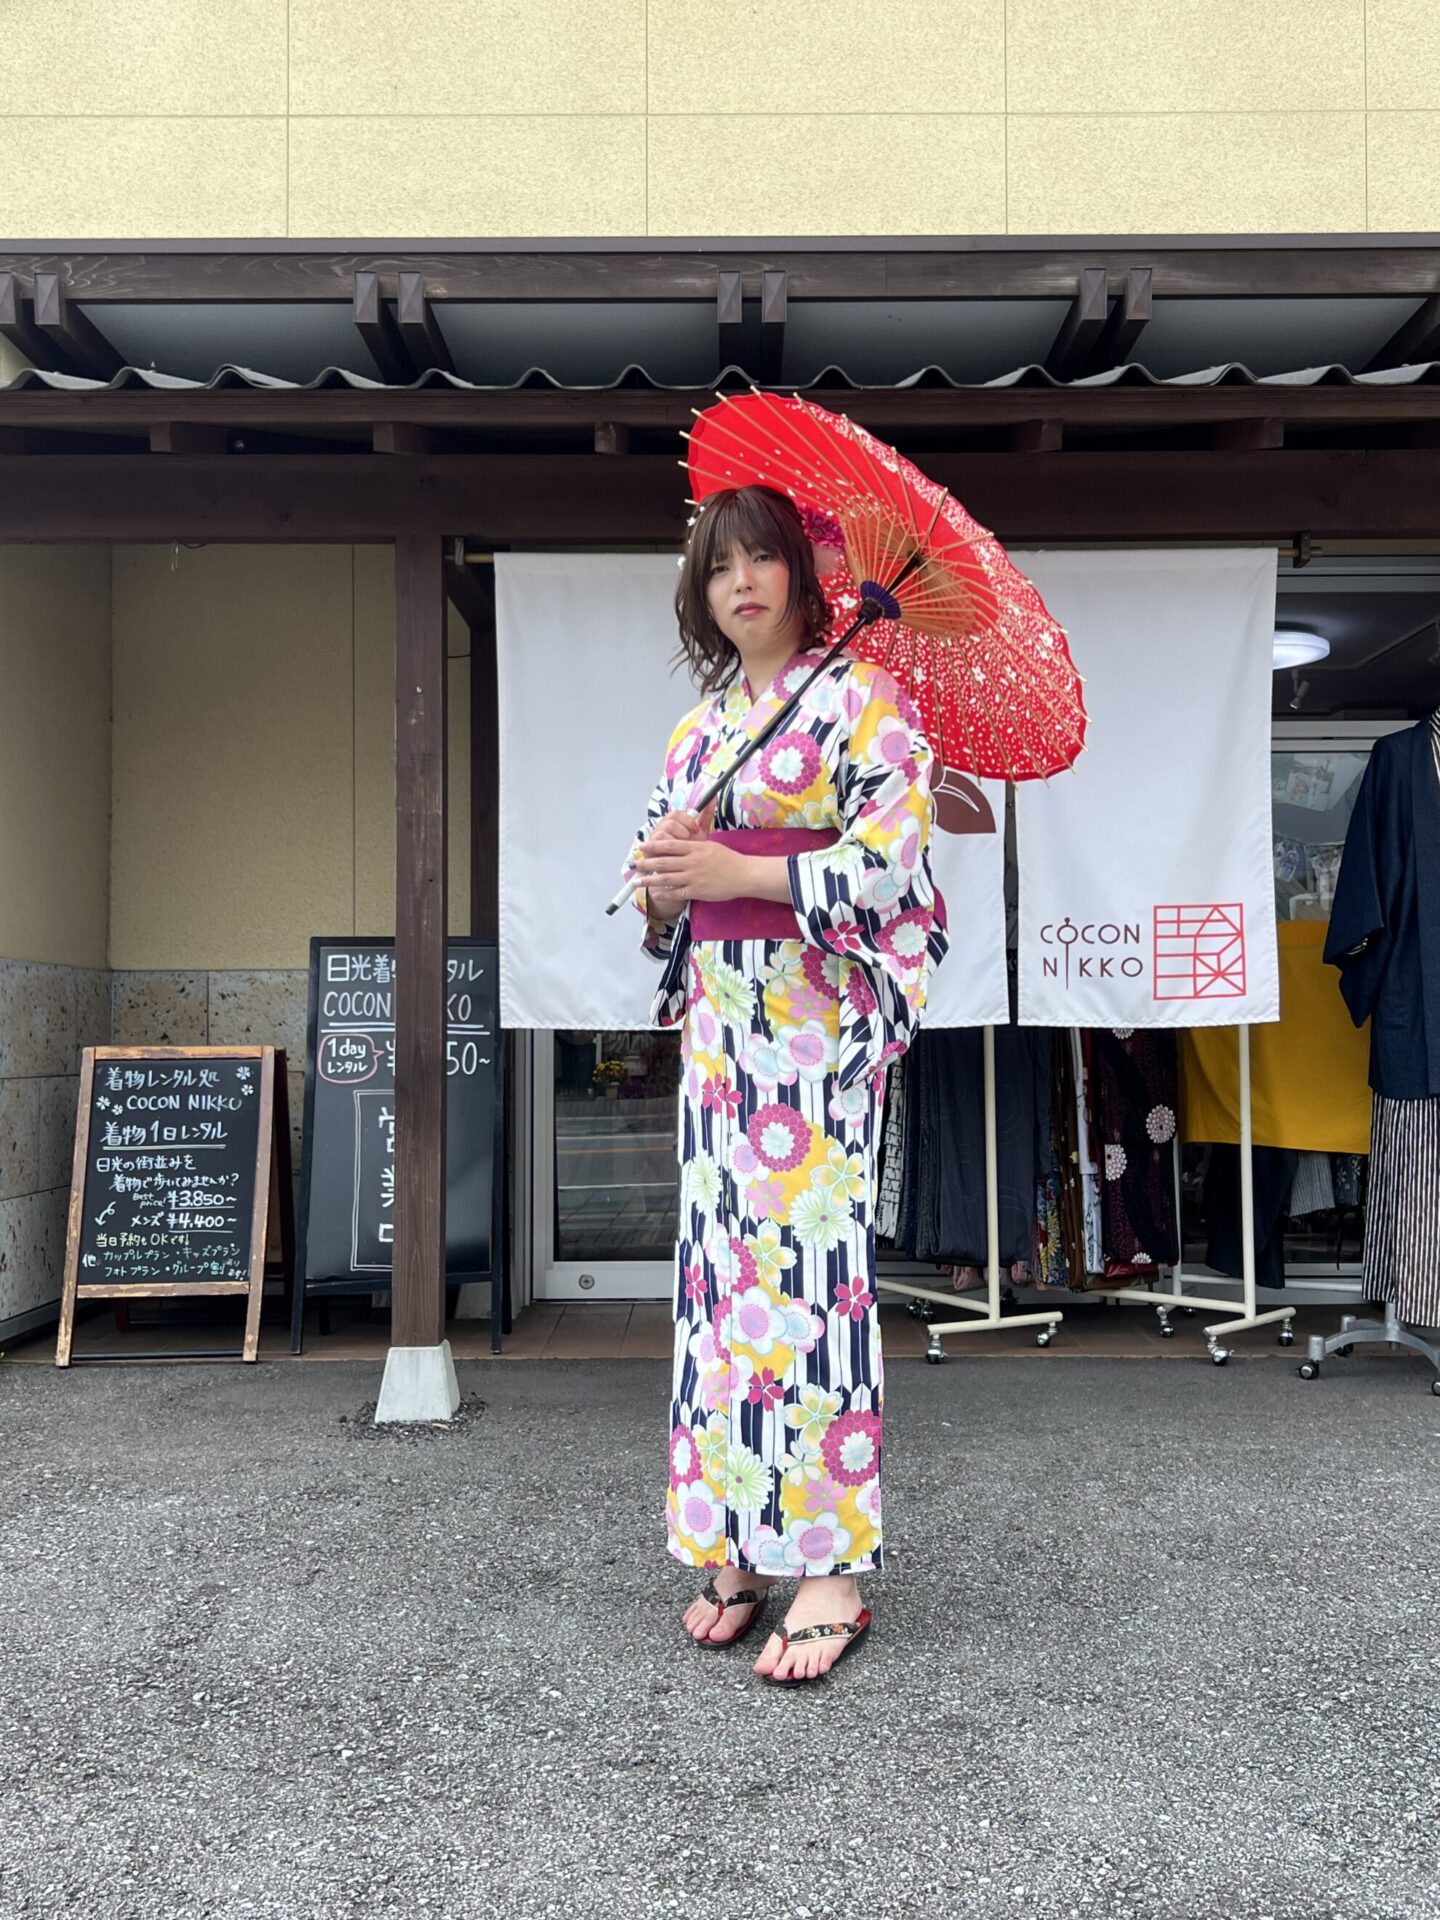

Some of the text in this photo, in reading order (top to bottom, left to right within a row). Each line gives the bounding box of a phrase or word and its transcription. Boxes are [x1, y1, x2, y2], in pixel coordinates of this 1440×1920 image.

[1040, 918, 1140, 945] COCON
[1043, 957, 1143, 985] NIKKO
[323, 991, 392, 1018] COCON
[328, 1061, 368, 1074] レンタル
[105, 1066, 220, 1091] 着物レンタル処
[126, 1095, 242, 1112] COCON NIKKO
[100, 1120, 228, 1146] 着物1日レンタル
[96, 1154, 197, 1172] 日光の街並みを
[131, 1212, 164, 1227] メンズ
[82, 1253, 97, 1267] 他
